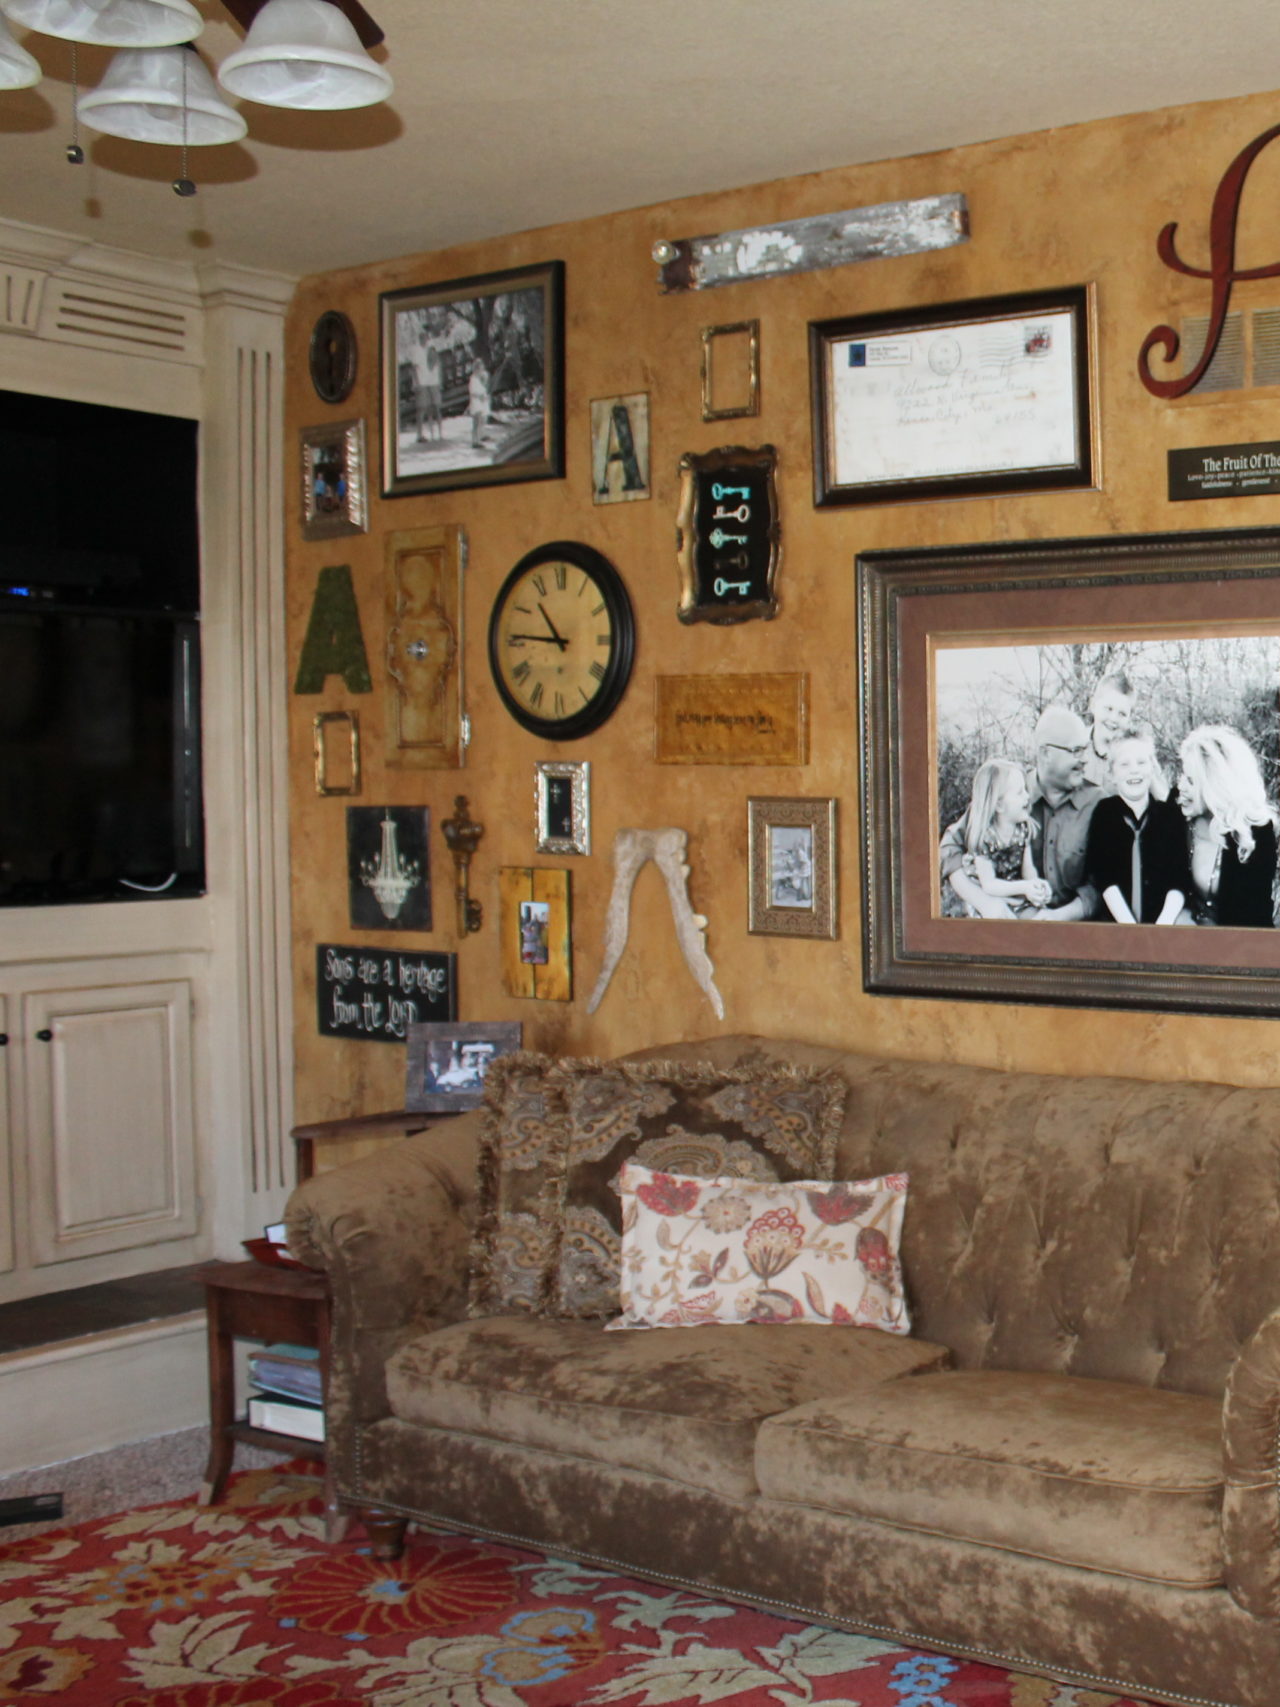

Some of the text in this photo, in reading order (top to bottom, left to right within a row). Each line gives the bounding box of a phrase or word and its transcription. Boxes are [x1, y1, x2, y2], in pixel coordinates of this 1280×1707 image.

[598, 405, 646, 494] A
[1202, 457, 1222, 473] The
[1223, 455, 1248, 471] Fruit
[1249, 453, 1263, 469] Of
[294, 563, 373, 695] A
